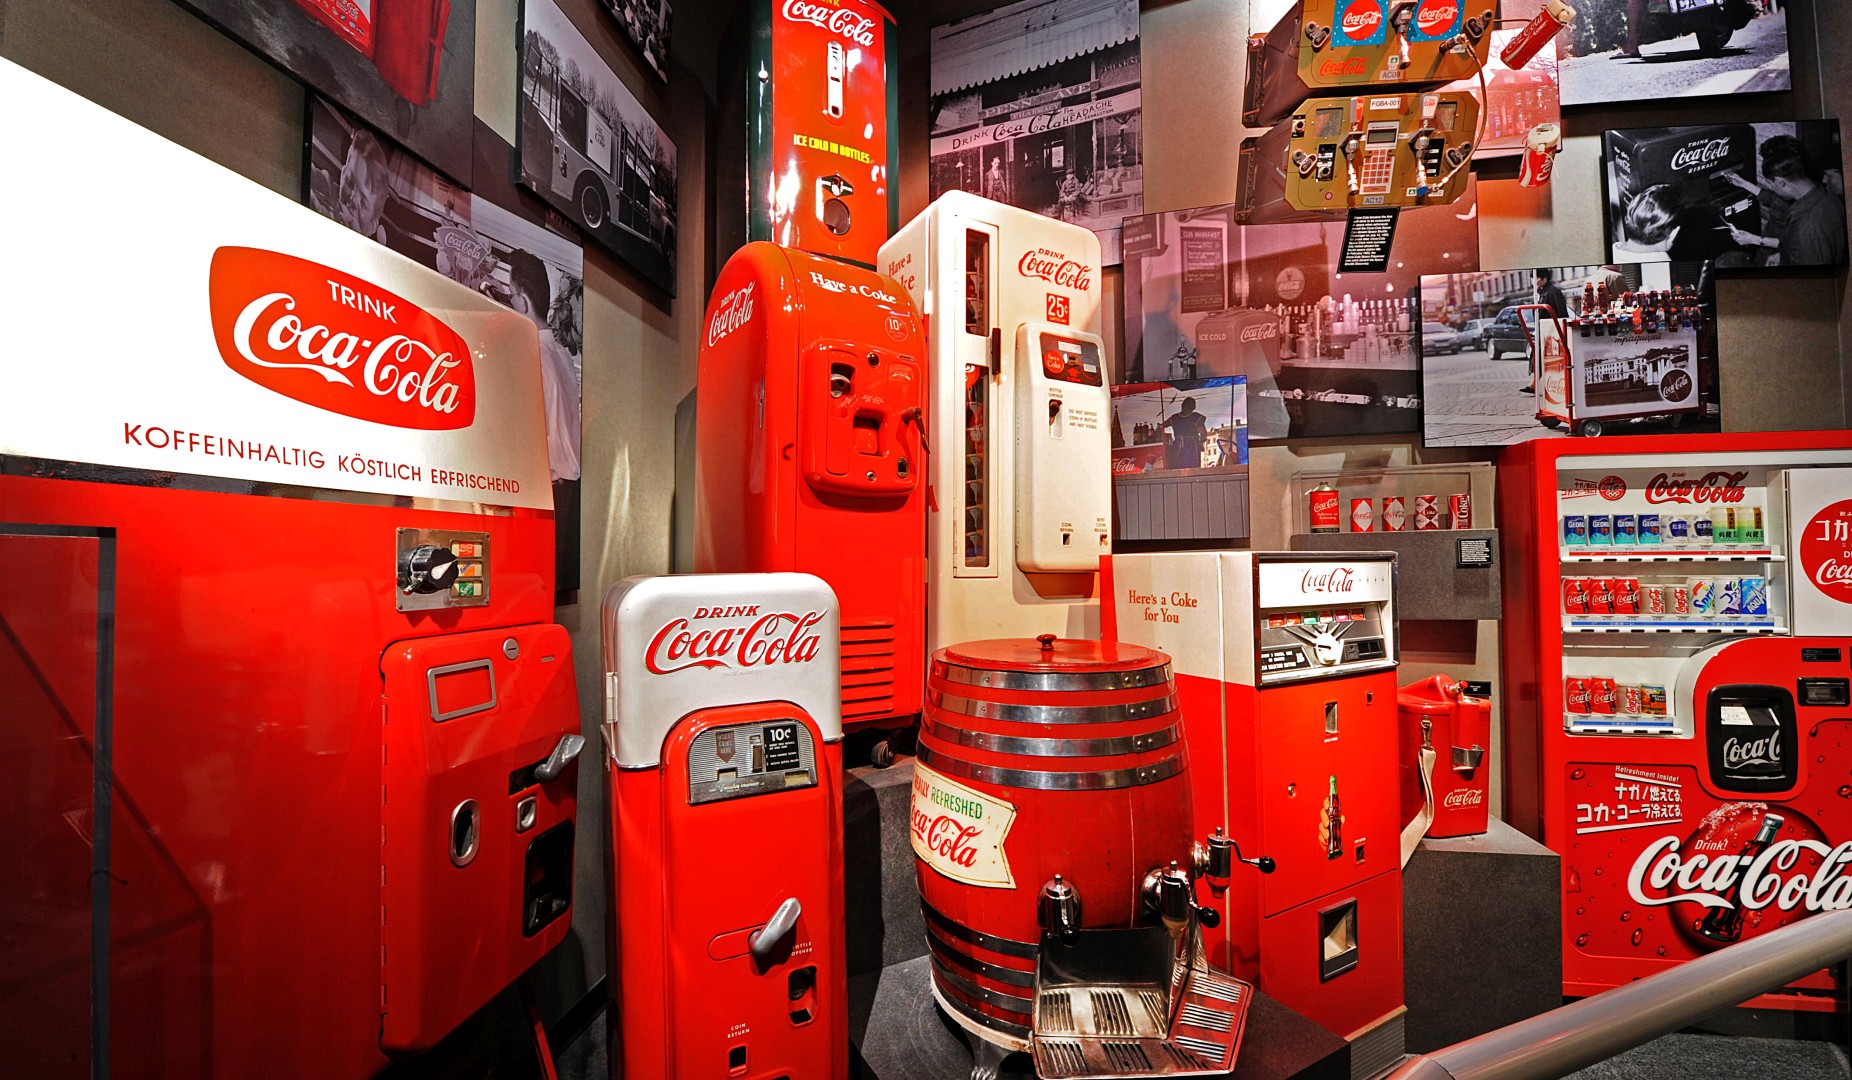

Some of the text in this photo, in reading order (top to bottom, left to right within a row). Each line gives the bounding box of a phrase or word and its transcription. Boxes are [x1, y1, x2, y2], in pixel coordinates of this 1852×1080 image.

[782, 0, 876, 47] Coca-Cola
[1343, 9, 1382, 26] Coca-Cola
[1418, 6, 1458, 24] Coca-Cola
[1320, 57, 1368, 77] Coca-Cola
[1382, 71, 1400, 79] AC09
[985, 82, 1091, 118] PENN AVE
[952, 129, 989, 149] DRINK
[993, 124, 1026, 142] Coca
[1027, 109, 1064, 134] Cola
[1063, 100, 1113, 126] HEADACHE
[793, 134, 870, 164] ICE COLD IN BOTTLES
[1671, 136, 1731, 171] Coca-Cola
[1687, 138, 1709, 148] TRINK
[1688, 160, 1718, 174] EISKALT
[444, 231, 483, 260] Coca-Cola
[1037, 247, 1065, 260] DRINK
[1018, 250, 1093, 291] Coca-Cola
[809, 271, 897, 304] Have a Coke
[900, 275, 915, 291] ke
[327, 279, 397, 323] TRINK
[708, 279, 757, 347] Coca-Cola
[1240, 322, 1278, 343] Coca-Cola
[233, 292, 462, 414] Coca-Cola
[1662, 374, 1689, 398] Coca-Cola
[124, 422, 520, 494] KOFFEINHALTIG KÖSTLICH ERFRISCHEND
[1645, 471, 1749, 505] Coca-Cola
[1457, 497, 1469, 518] Coke
[1301, 567, 1355, 593] Coca-Cola
[1129, 590, 1197, 608] Here's a Coke
[693, 606, 760, 619] DRINK
[1144, 607, 1179, 623] for You
[645, 608, 828, 676] Coca-Cola
[770, 728, 791, 741] 10¢
[1615, 765, 1679, 782] Refreshment Inside!
[931, 787, 983, 819] REFRESHED
[1443, 789, 1483, 807] Coca-Cola
[1694, 839, 1729, 851] Drink!
[1627, 835, 1852, 911] Coca-Cola
[791, 947, 813, 957] OPENER
[727, 1028, 750, 1039] RETURN
[730, 1022, 746, 1031] COIN
